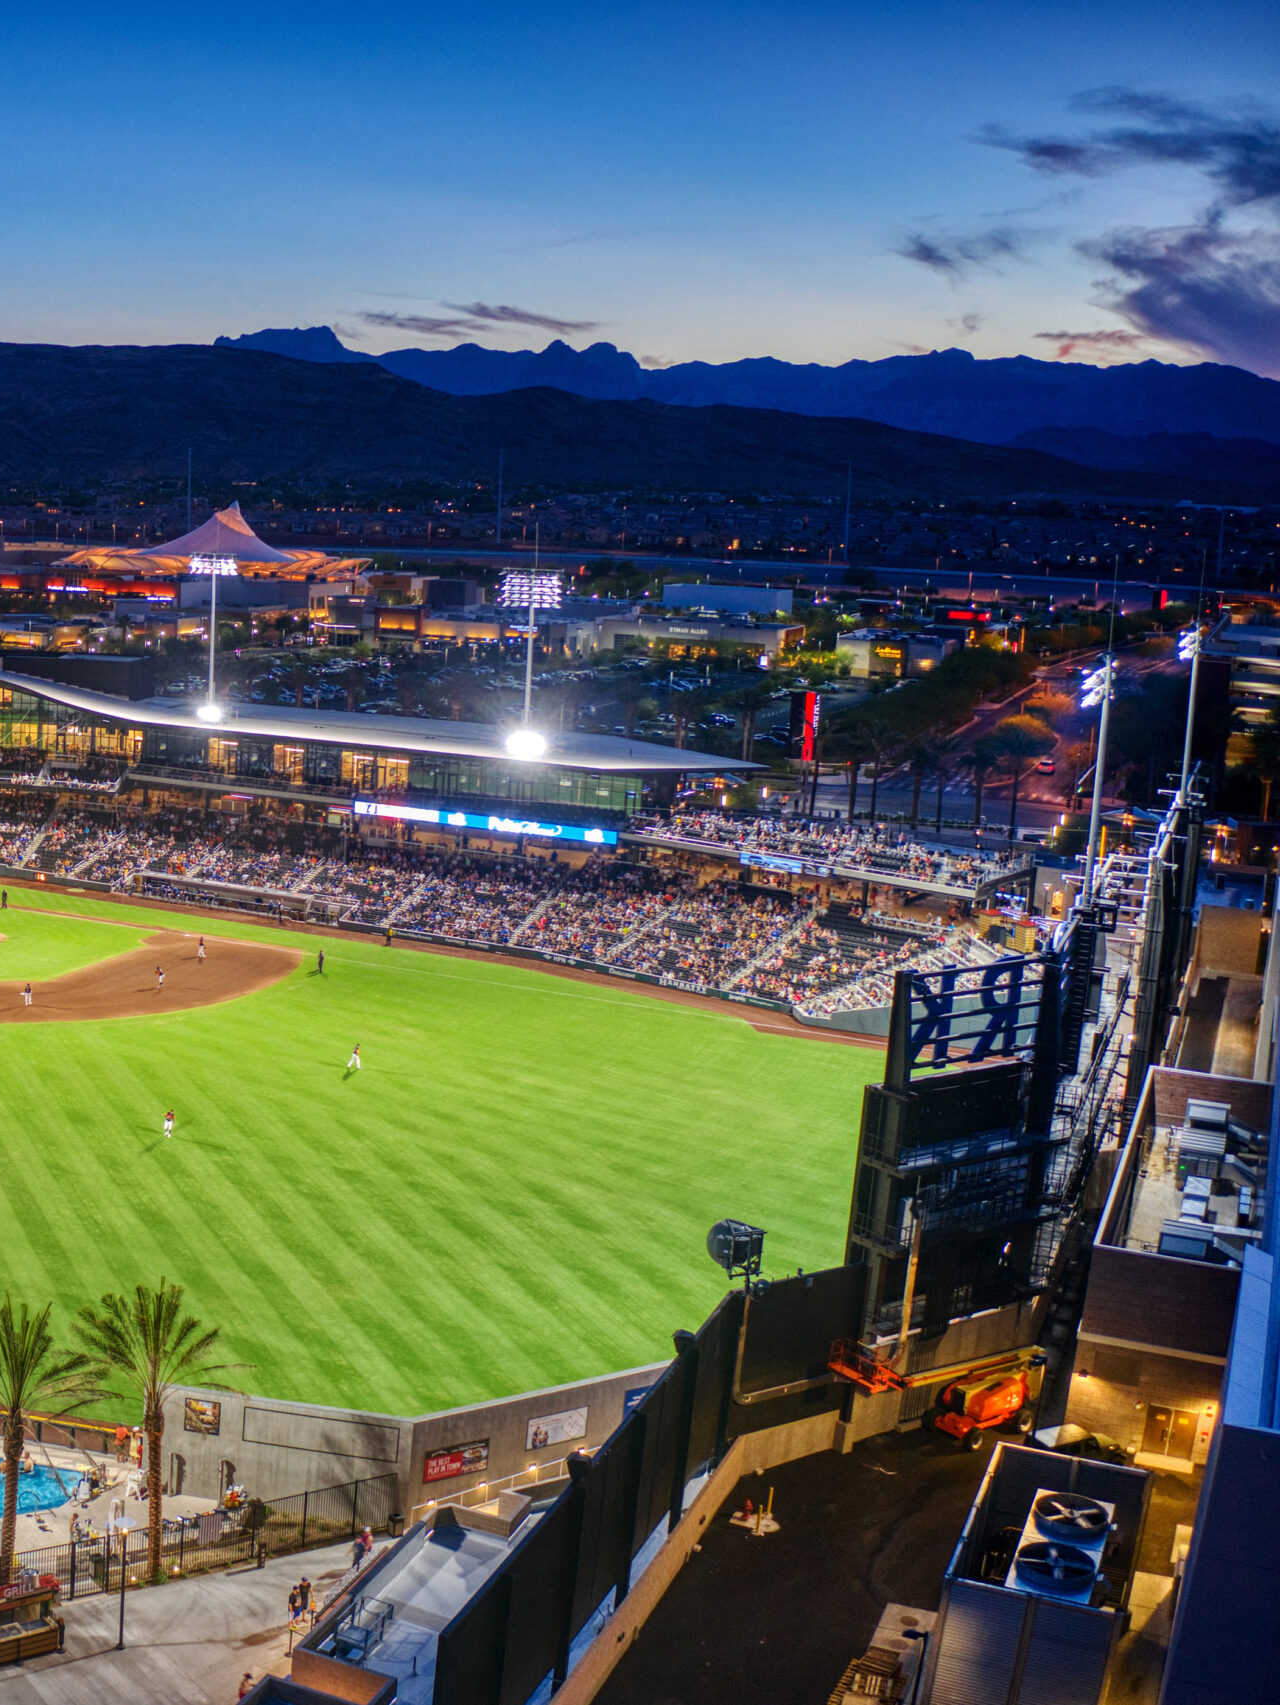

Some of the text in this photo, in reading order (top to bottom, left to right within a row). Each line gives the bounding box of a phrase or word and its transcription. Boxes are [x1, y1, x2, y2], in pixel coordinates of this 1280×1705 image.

[427, 1462, 461, 1476] PLAY IN TOWN
[428, 1456, 451, 1468] THE BEST
[3, 1583, 34, 1598] GRILL
